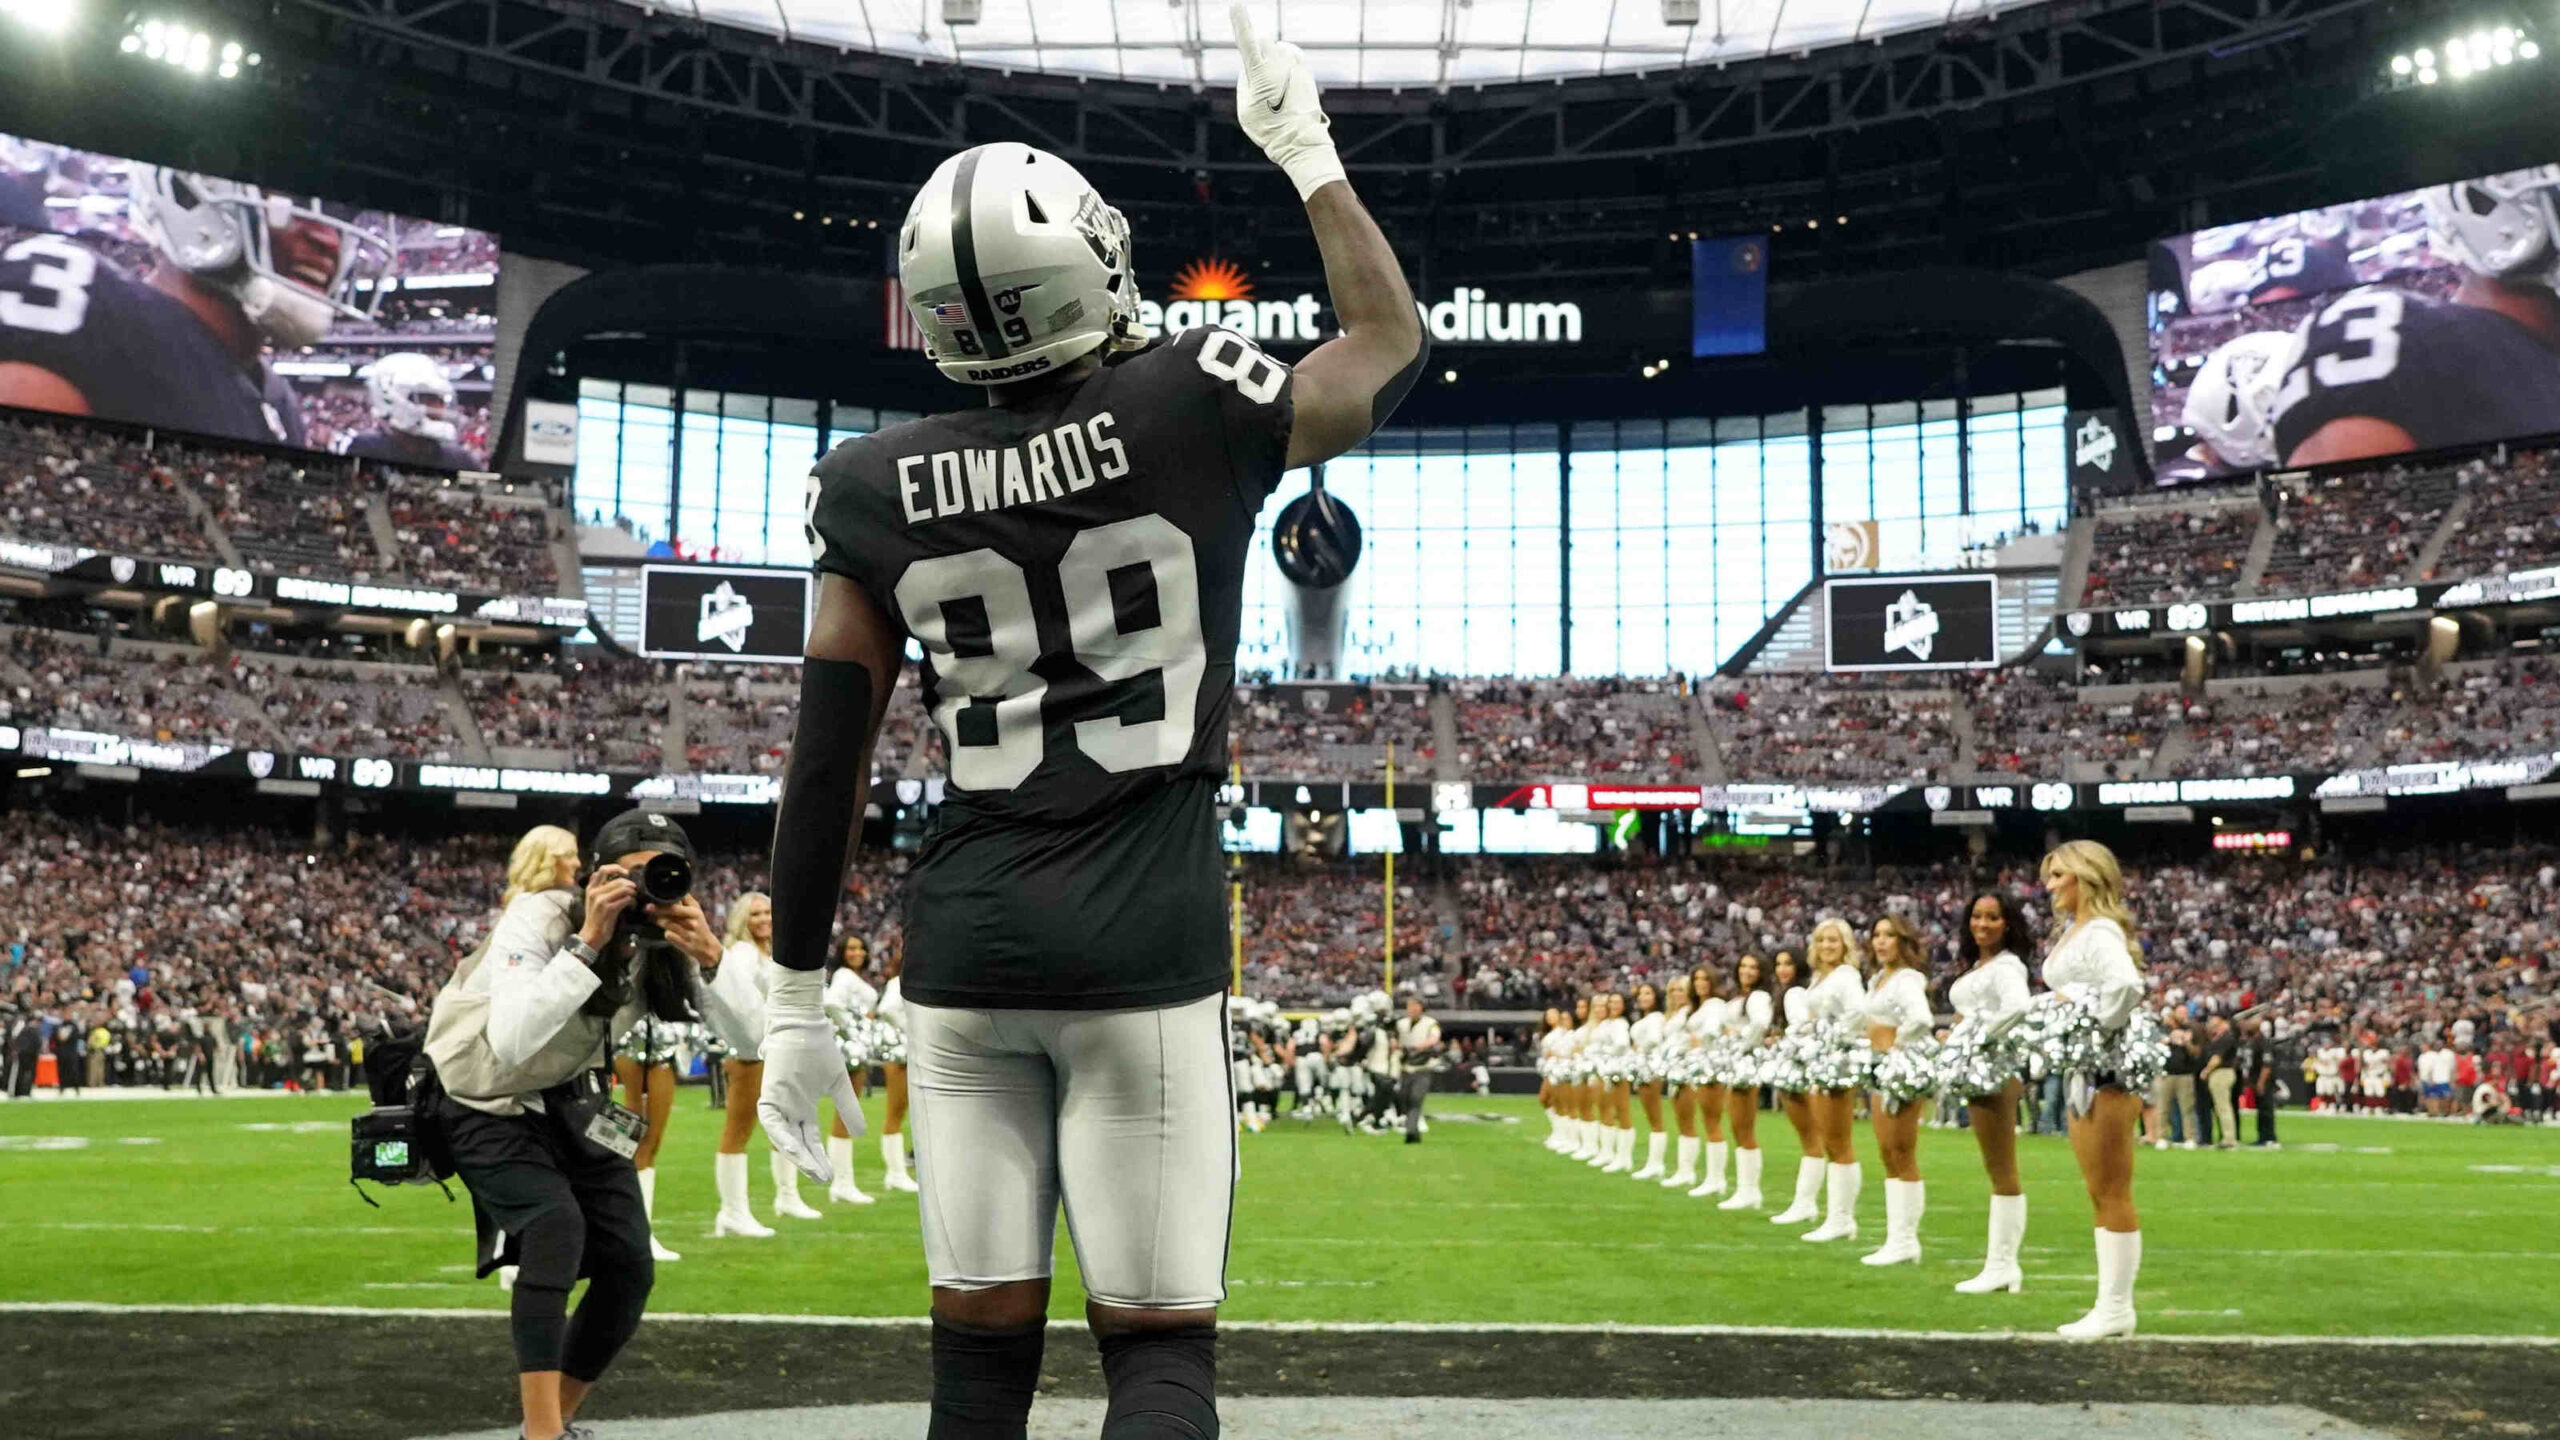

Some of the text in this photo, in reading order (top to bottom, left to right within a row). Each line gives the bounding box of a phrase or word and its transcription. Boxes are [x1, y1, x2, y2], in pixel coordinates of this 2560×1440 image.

[1000, 296, 1020, 309] AL
[1138, 293, 1321, 341] egiant
[1415, 287, 1583, 342] dium
[1003, 316, 1032, 348] 9
[968, 356, 1051, 382] RAIDERS
[897, 411, 1130, 524] EDWARDS
[159, 564, 197, 588] WR
[212, 567, 254, 597] 89
[2114, 609, 2151, 630] WR
[2167, 602, 2208, 631] 89
[894, 513, 1207, 791] 89
[299, 757, 336, 780] WR
[352, 757, 394, 789] 89
[1976, 786, 2014, 808] WR
[2031, 782, 2074, 811] 89
